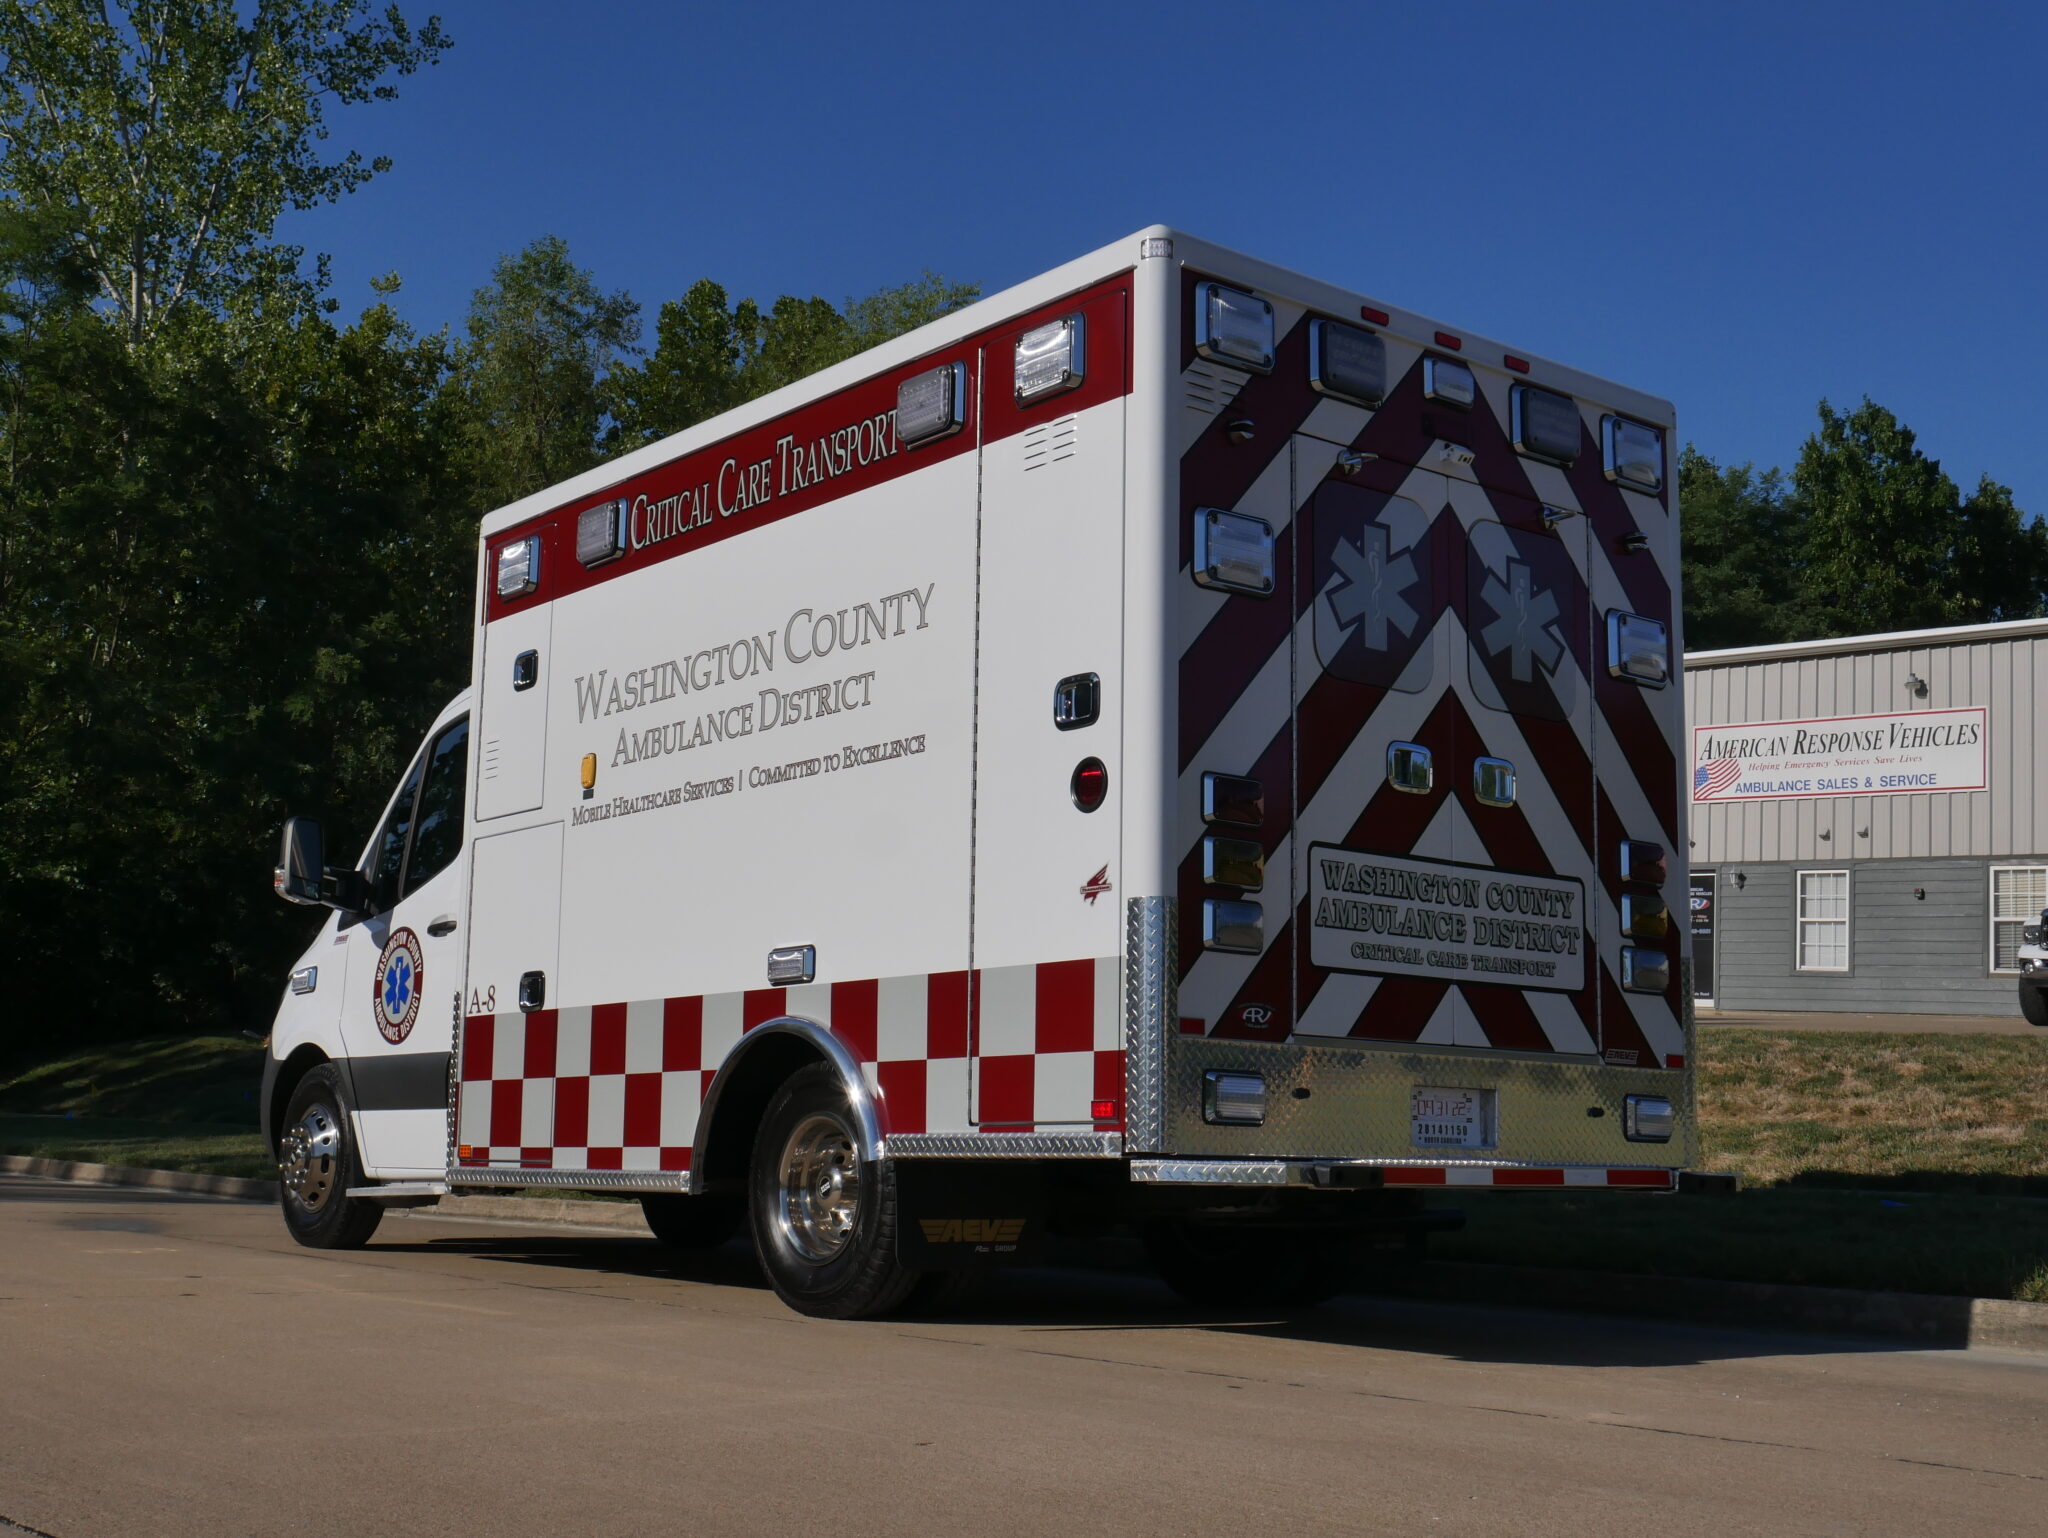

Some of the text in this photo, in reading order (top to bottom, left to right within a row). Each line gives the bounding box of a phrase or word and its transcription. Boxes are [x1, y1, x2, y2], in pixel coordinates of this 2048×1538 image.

[630, 408, 898, 550] CRITICAL CARE TRANSPORT
[575, 583, 935, 724] WASHINGTON COUNTY
[611, 671, 876, 768] AMBULANCE DISTRICT
[1700, 723, 1980, 760] AMERICAN RESPONSE VEHICLES
[571, 803, 612, 826] MOBILE
[612, 787, 681, 818] HEALTHCARE
[683, 776, 734, 804] SERVICES
[748, 757, 821, 790] COMMITTED
[823, 753, 841, 773] TO
[842, 734, 926, 769] EXCELLENCE
[1735, 773, 1937, 793] AMBULANCE SALES & SERVICE
[1748, 755, 1923, 772] Helping Emergency Services Save Lives
[1320, 859, 1575, 919] WASHINGTON COUNTY
[1315, 897, 1580, 955] AMBULANCE DISTRICT
[376, 931, 423, 981] WASHINGTON COUNTY
[1350, 941, 1556, 978] CRITICAL CARE TRANSPORT
[374, 992, 420, 1041] AMBULANCE DISTRICT
[468, 985, 496, 1015] A-8
[1243, 1007, 1272, 1023] ARV
